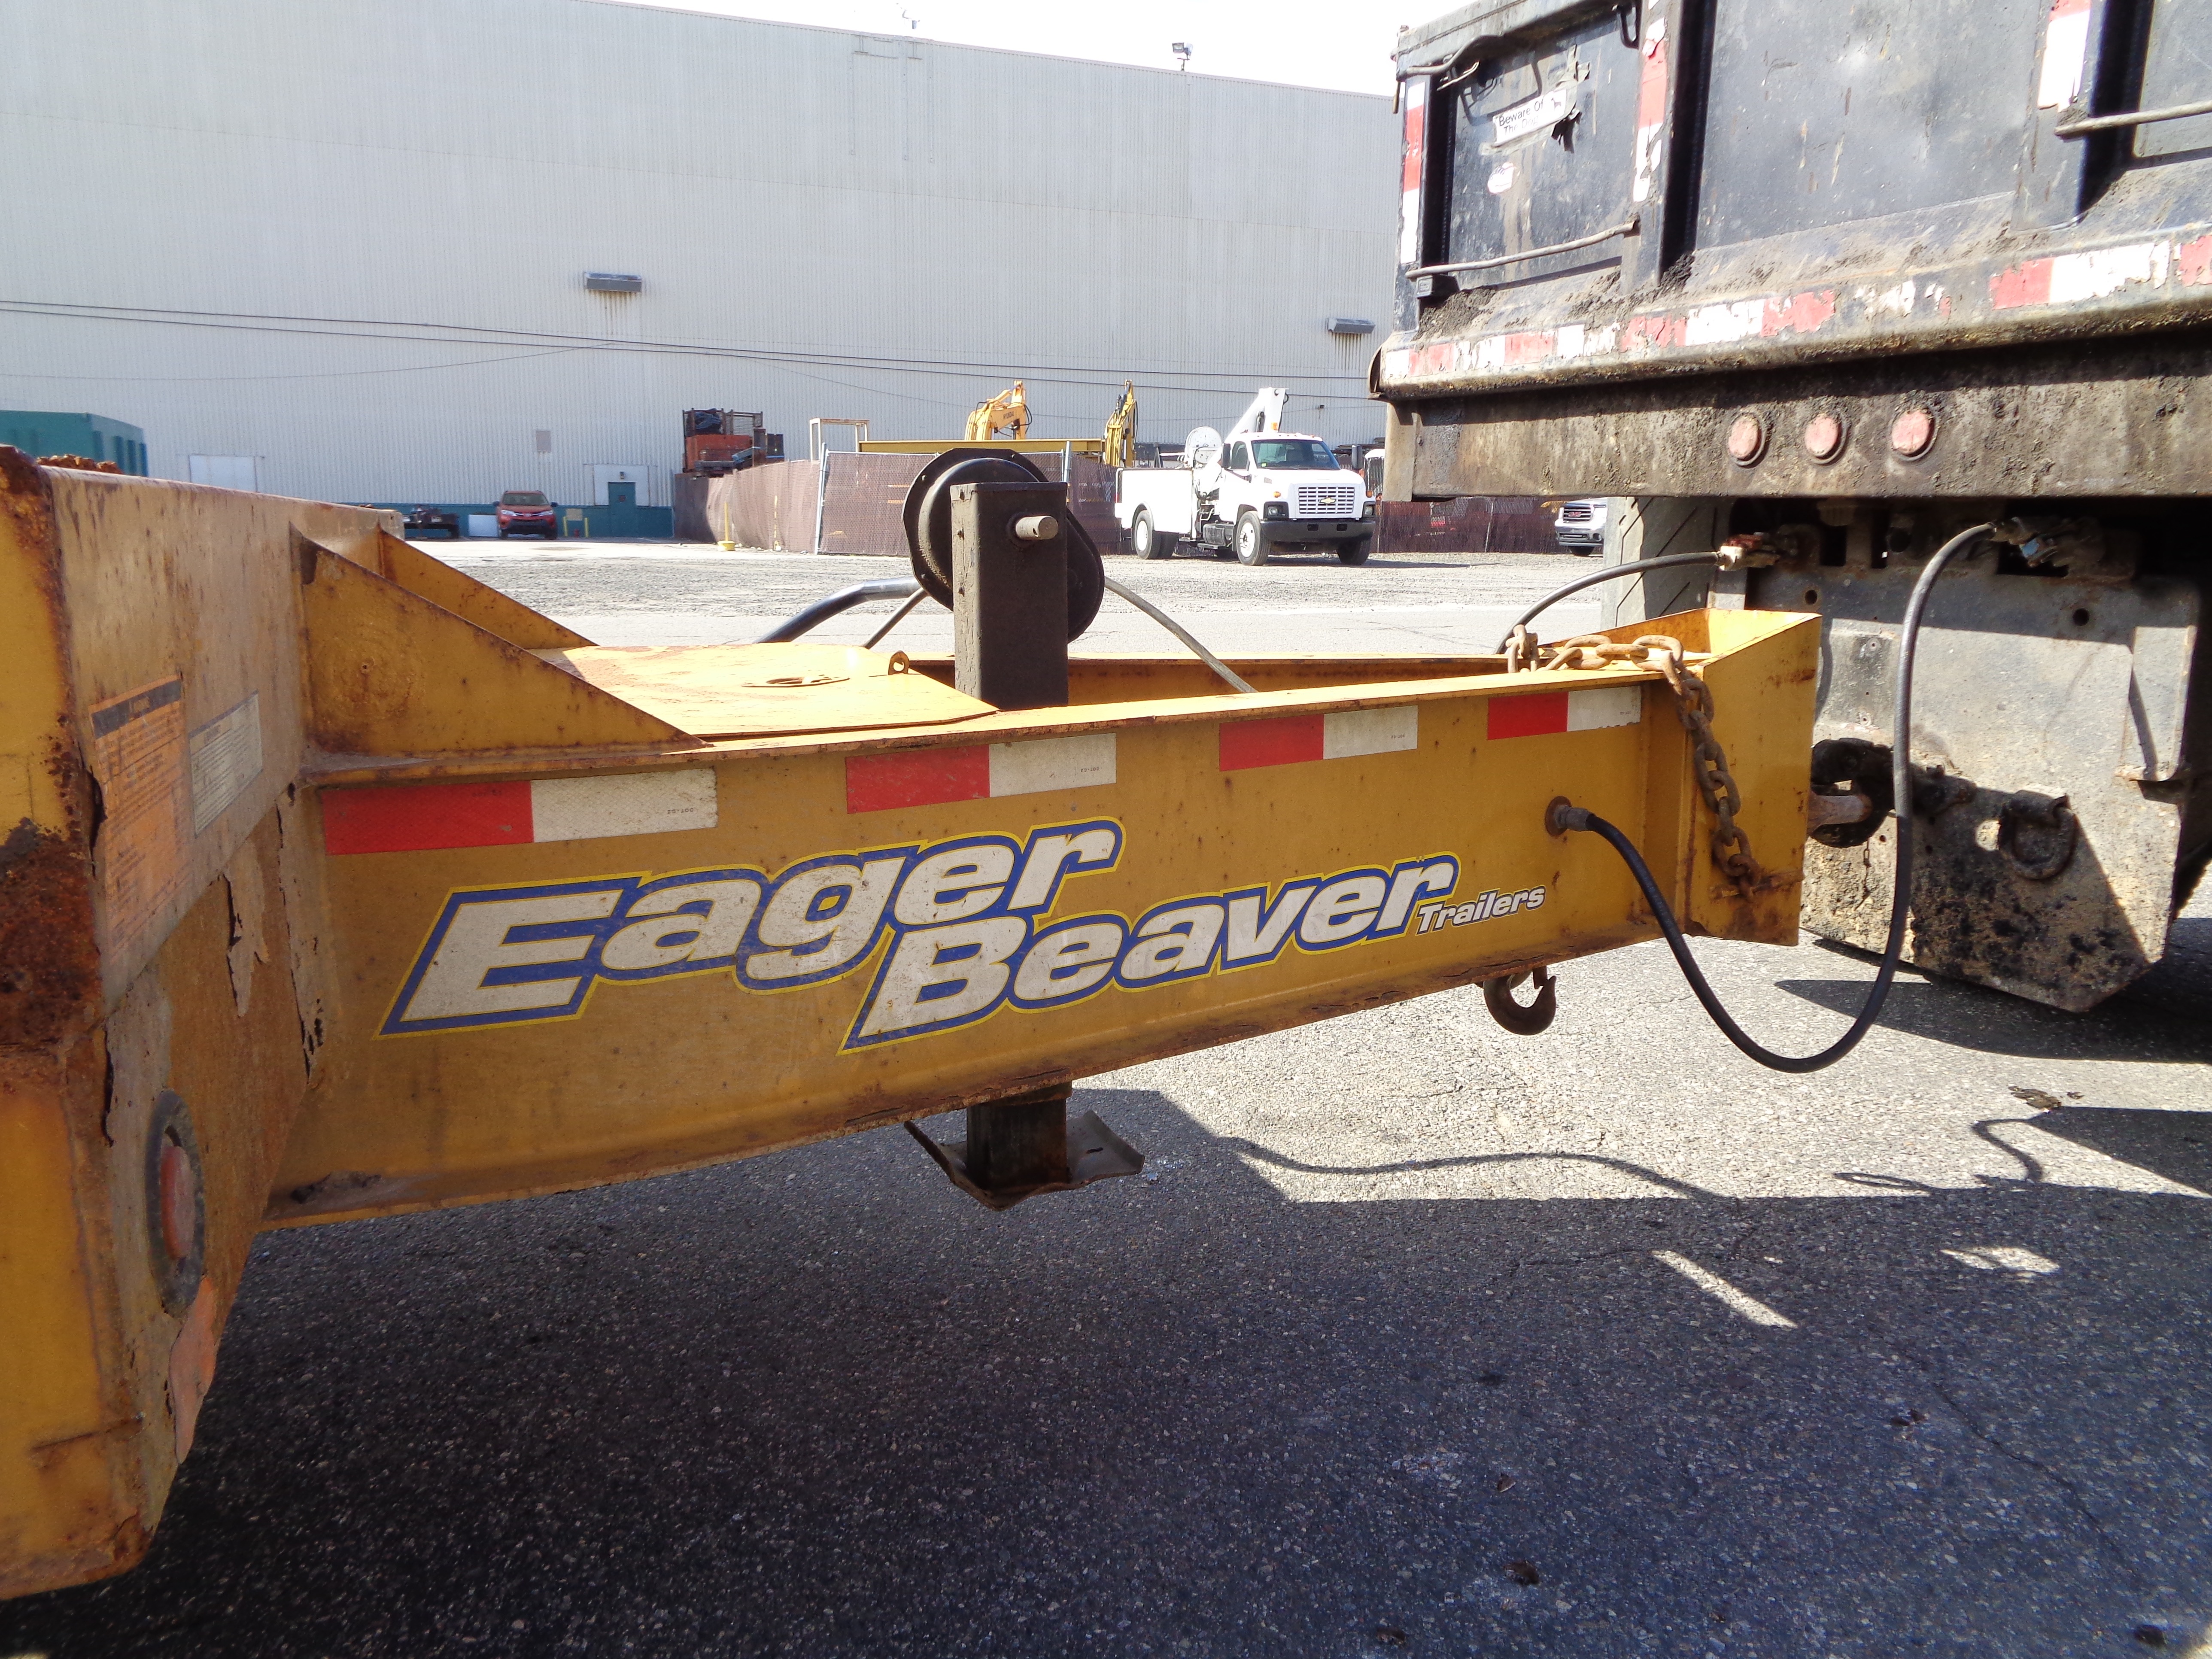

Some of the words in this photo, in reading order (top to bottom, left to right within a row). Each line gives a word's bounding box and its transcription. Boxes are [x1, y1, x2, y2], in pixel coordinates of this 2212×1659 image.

[1499, 109, 1531, 127] Beware
[1534, 99, 1544, 111] Of
[1504, 124, 1519, 135] The
[380, 820, 1121, 1034] Eager
[1416, 886, 1545, 935] Trailers
[846, 856, 1458, 1050] Beaver
